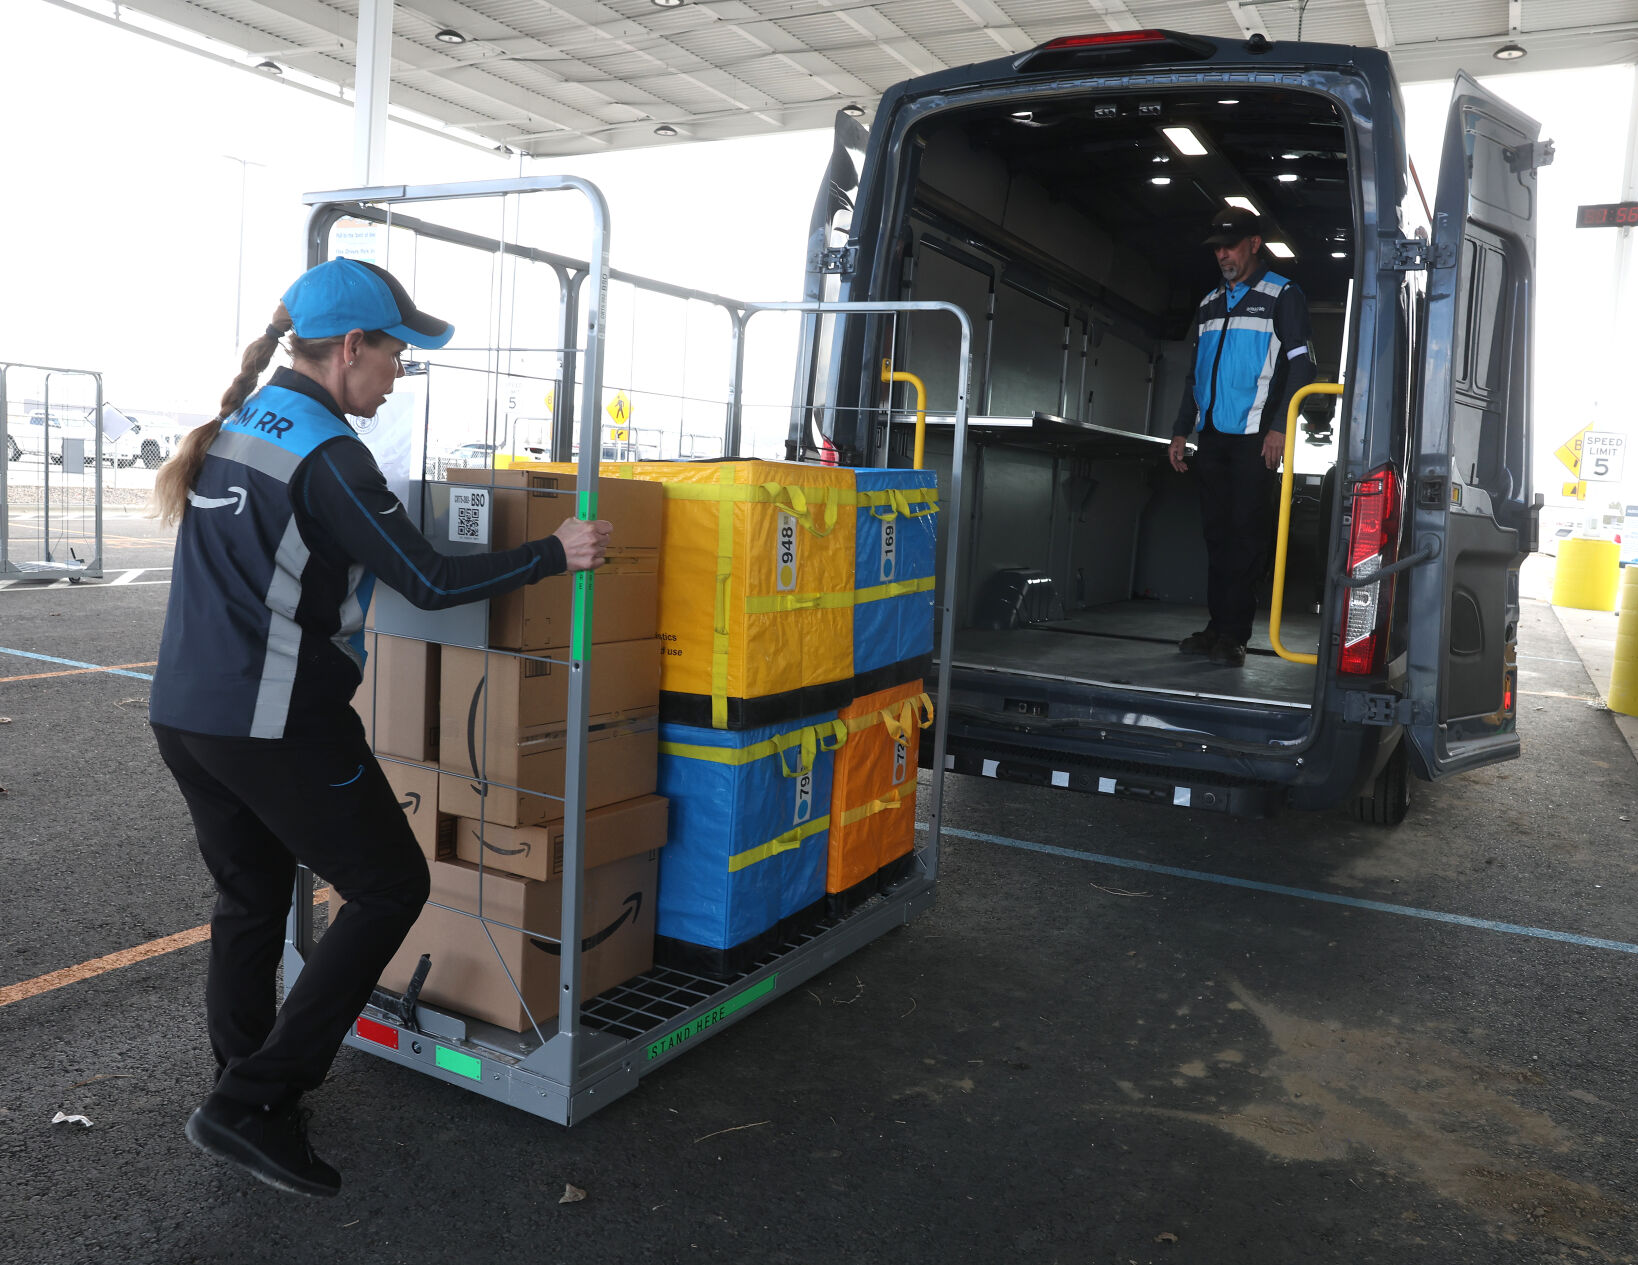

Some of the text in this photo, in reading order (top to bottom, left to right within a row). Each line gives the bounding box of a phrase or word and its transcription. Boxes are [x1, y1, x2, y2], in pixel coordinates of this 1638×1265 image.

[508, 396, 517, 409] 5
[253, 410, 295, 440] RR
[1587, 437, 1623, 446] SPEED
[1589, 447, 1618, 456] LIMIT
[1593, 458, 1609, 476] 5
[471, 493, 485, 507] BSO
[781, 526, 793, 564] 948
[885, 525, 894, 557] 169
[667, 648, 683, 656] use
[651, 1006, 726, 1060] STAND HERE
